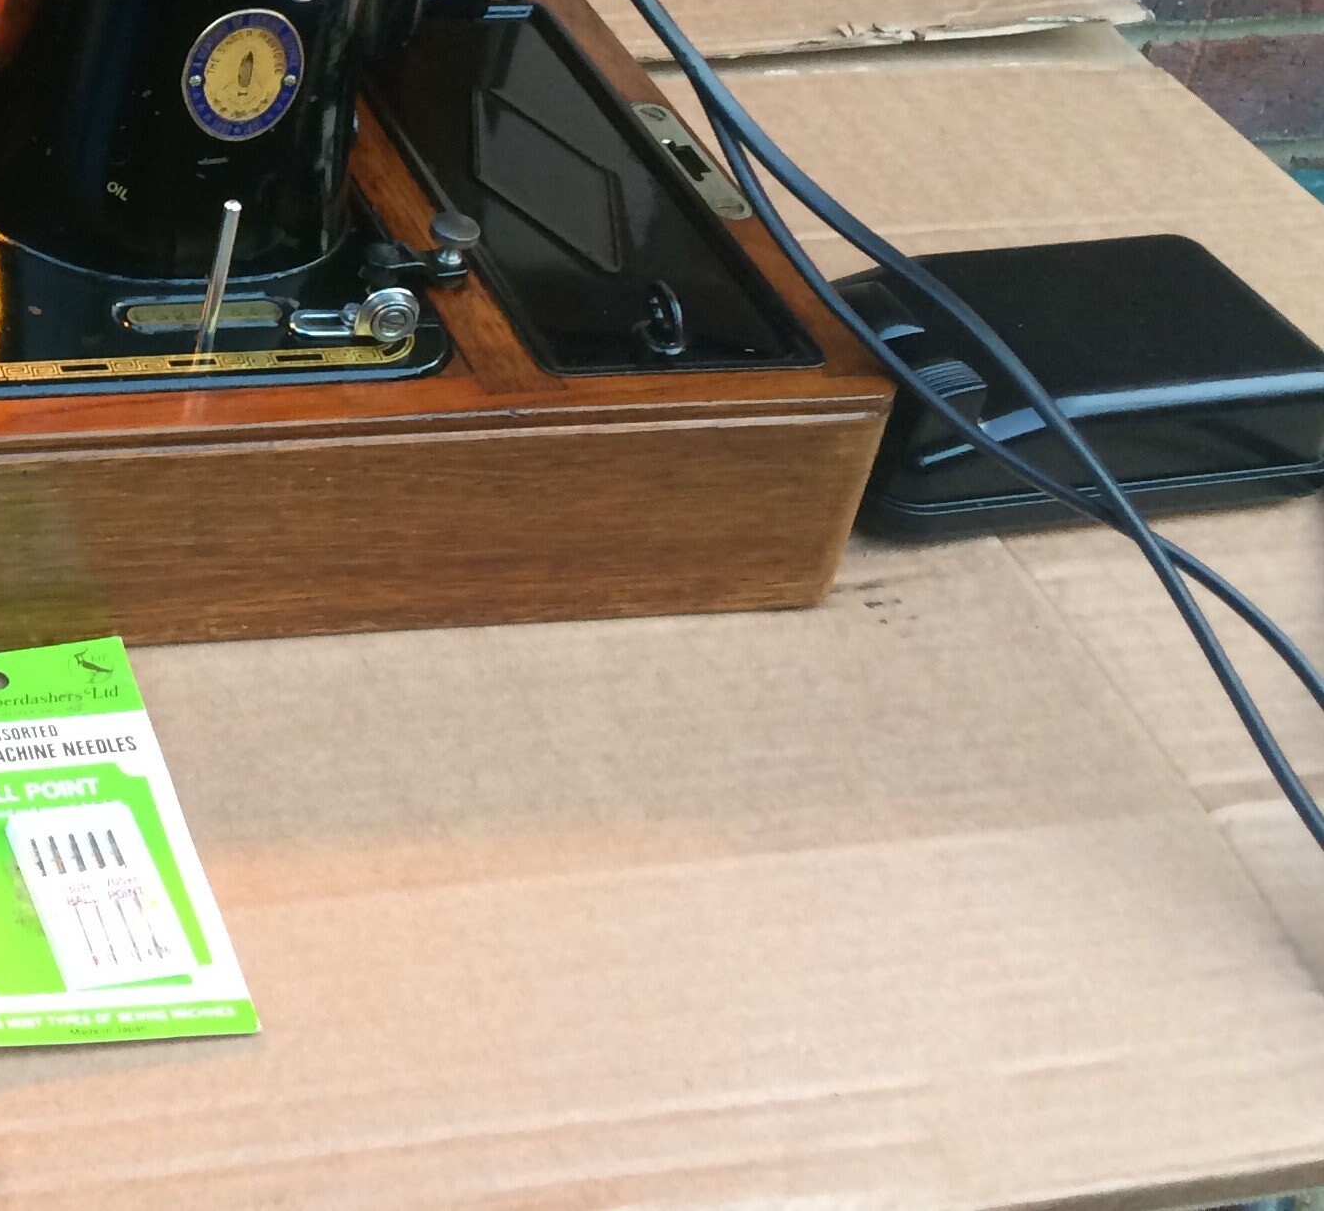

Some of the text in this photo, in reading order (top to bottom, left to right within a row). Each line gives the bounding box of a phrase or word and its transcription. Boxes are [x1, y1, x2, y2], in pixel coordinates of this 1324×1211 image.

[106, 180, 129, 202] OIL
[83, 684, 119, 700] Ltd
[62, 735, 138, 757] NEEDLES
[25, 776, 99, 801] POINT
[47, 1011, 91, 1027] TYPES
[95, 1012, 111, 1024] OF
